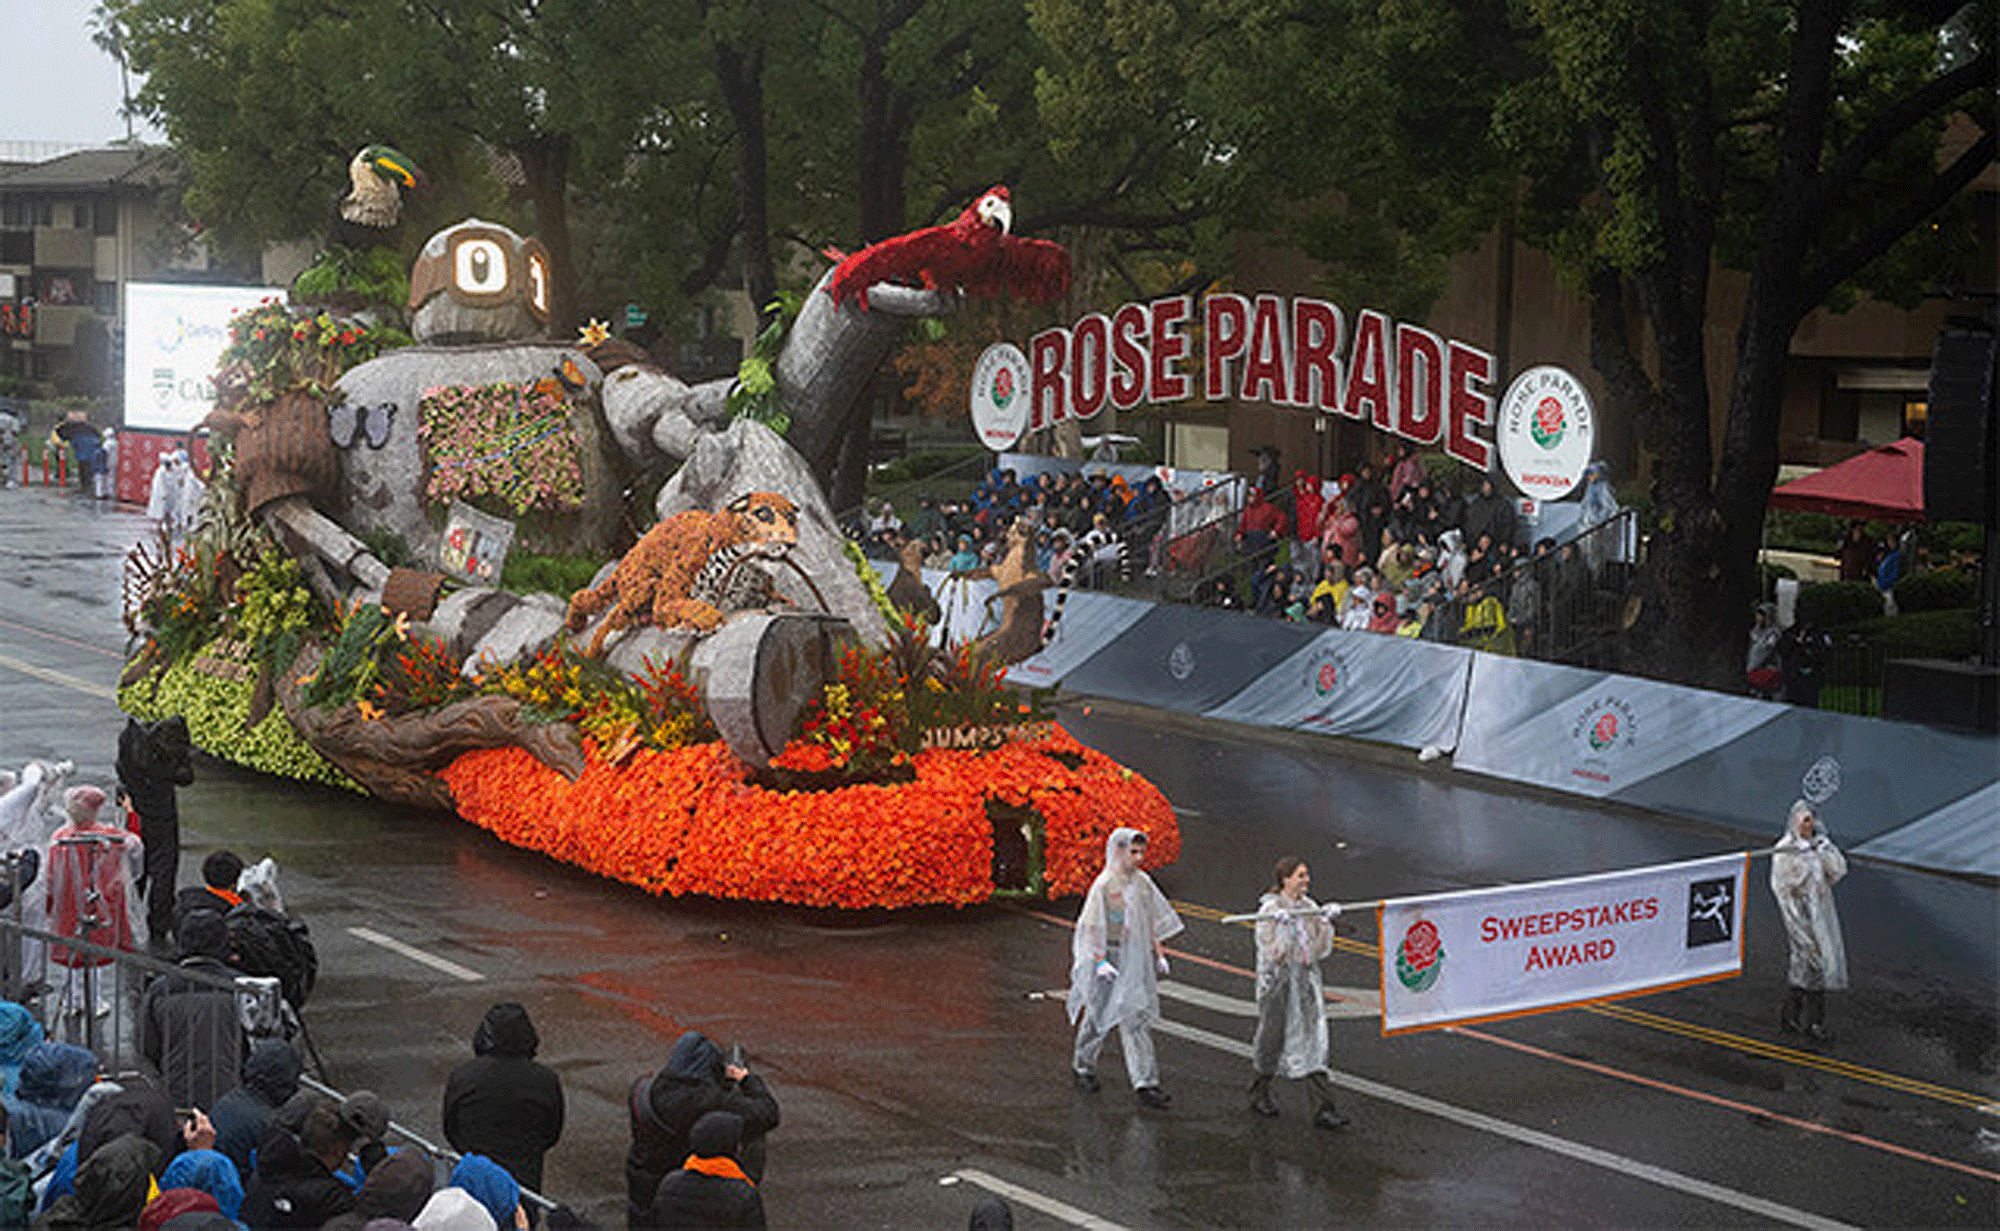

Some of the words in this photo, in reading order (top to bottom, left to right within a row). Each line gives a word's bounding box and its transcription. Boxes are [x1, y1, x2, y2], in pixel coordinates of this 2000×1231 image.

[1030, 295, 1193, 432] ROSE
[1205, 294, 1498, 473] PARADE
[1541, 374, 1588, 433] PARADE
[1480, 898, 1659, 942] SWEEPSTAKES
[1524, 939, 1616, 971] AWARD
